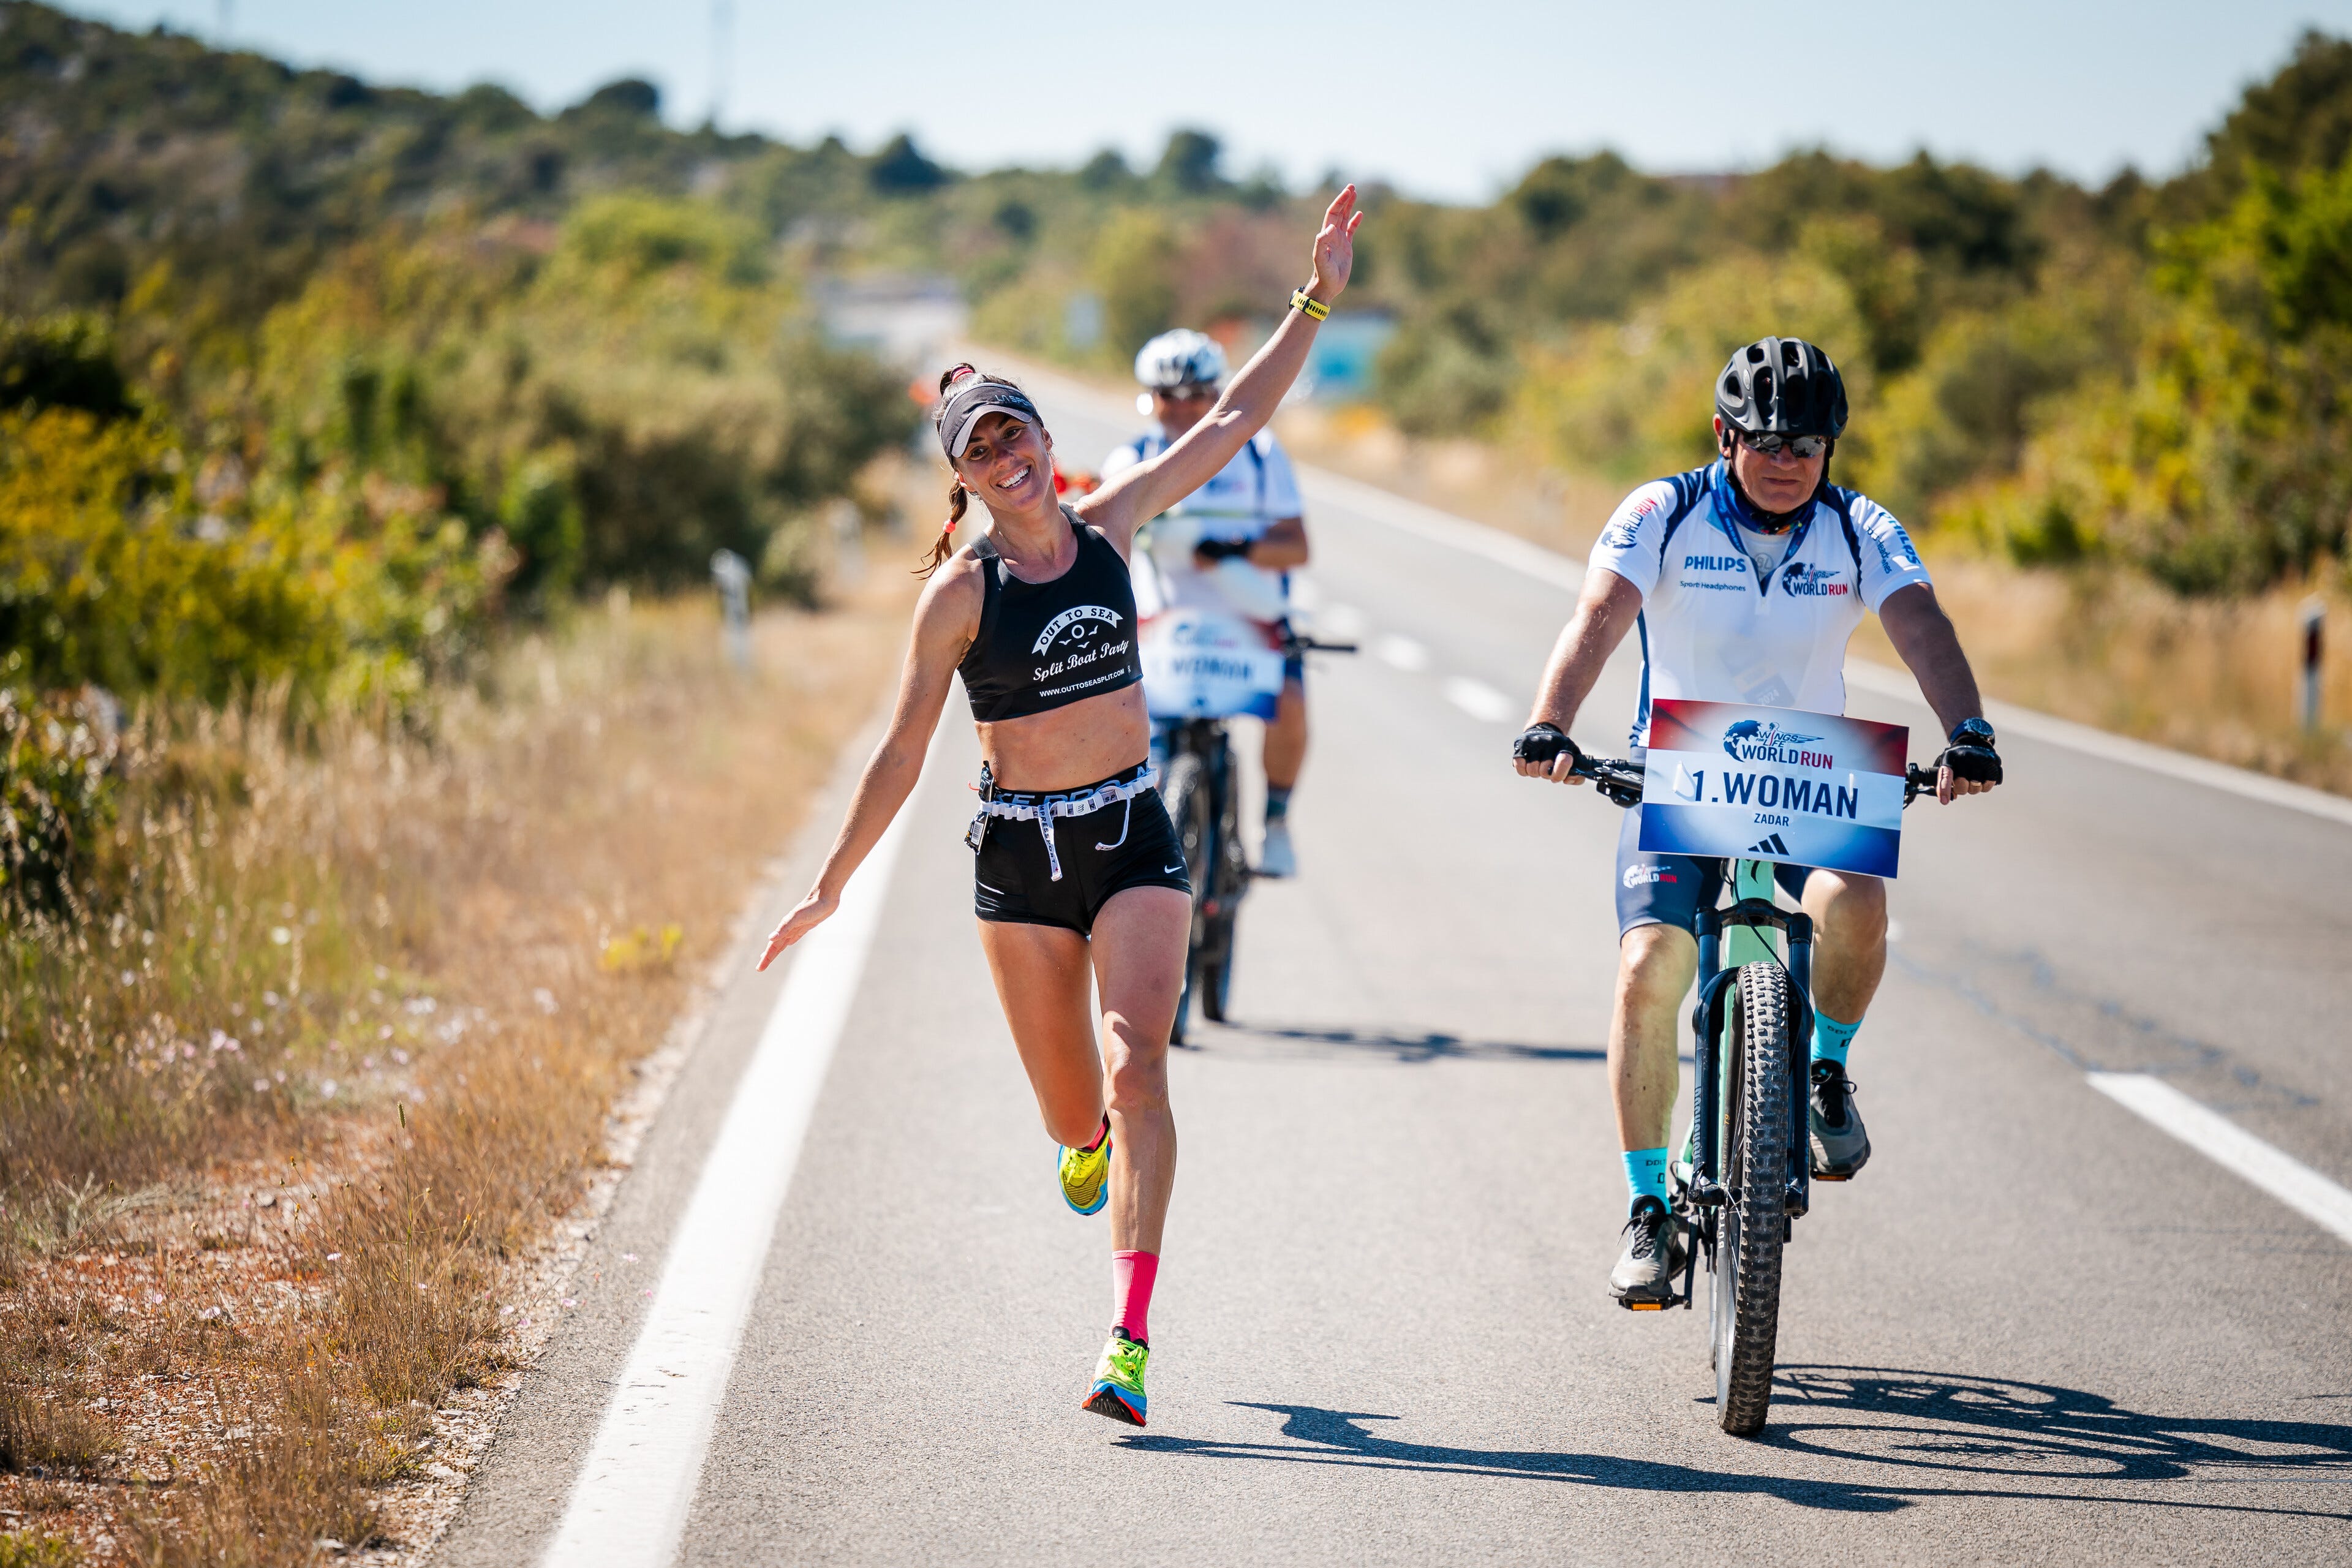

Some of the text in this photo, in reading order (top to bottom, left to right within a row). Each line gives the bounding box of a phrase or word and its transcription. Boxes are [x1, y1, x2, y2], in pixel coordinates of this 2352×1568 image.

[1634, 497, 1658, 516] RUN
[1684, 556, 1746, 572] PHILIPS
[1701, 582, 1746, 592] Headphones
[1793, 582, 1848, 595] WORLD RUN
[1040, 608, 1113, 645] OUT TO SEA
[1033, 640, 1129, 682] Split Boat Party
[1039, 668, 1125, 697] WWW.OUTTOSEASPLIT.COM
[1758, 729, 1799, 742] WINGS
[1762, 737, 1787, 748] LIFE
[1742, 745, 1833, 770] WORLD RUN
[1754, 813, 1789, 827] ZADAR
[1659, 873, 1677, 883] RUN
[1718, 1182, 1727, 1249] BUTCR
